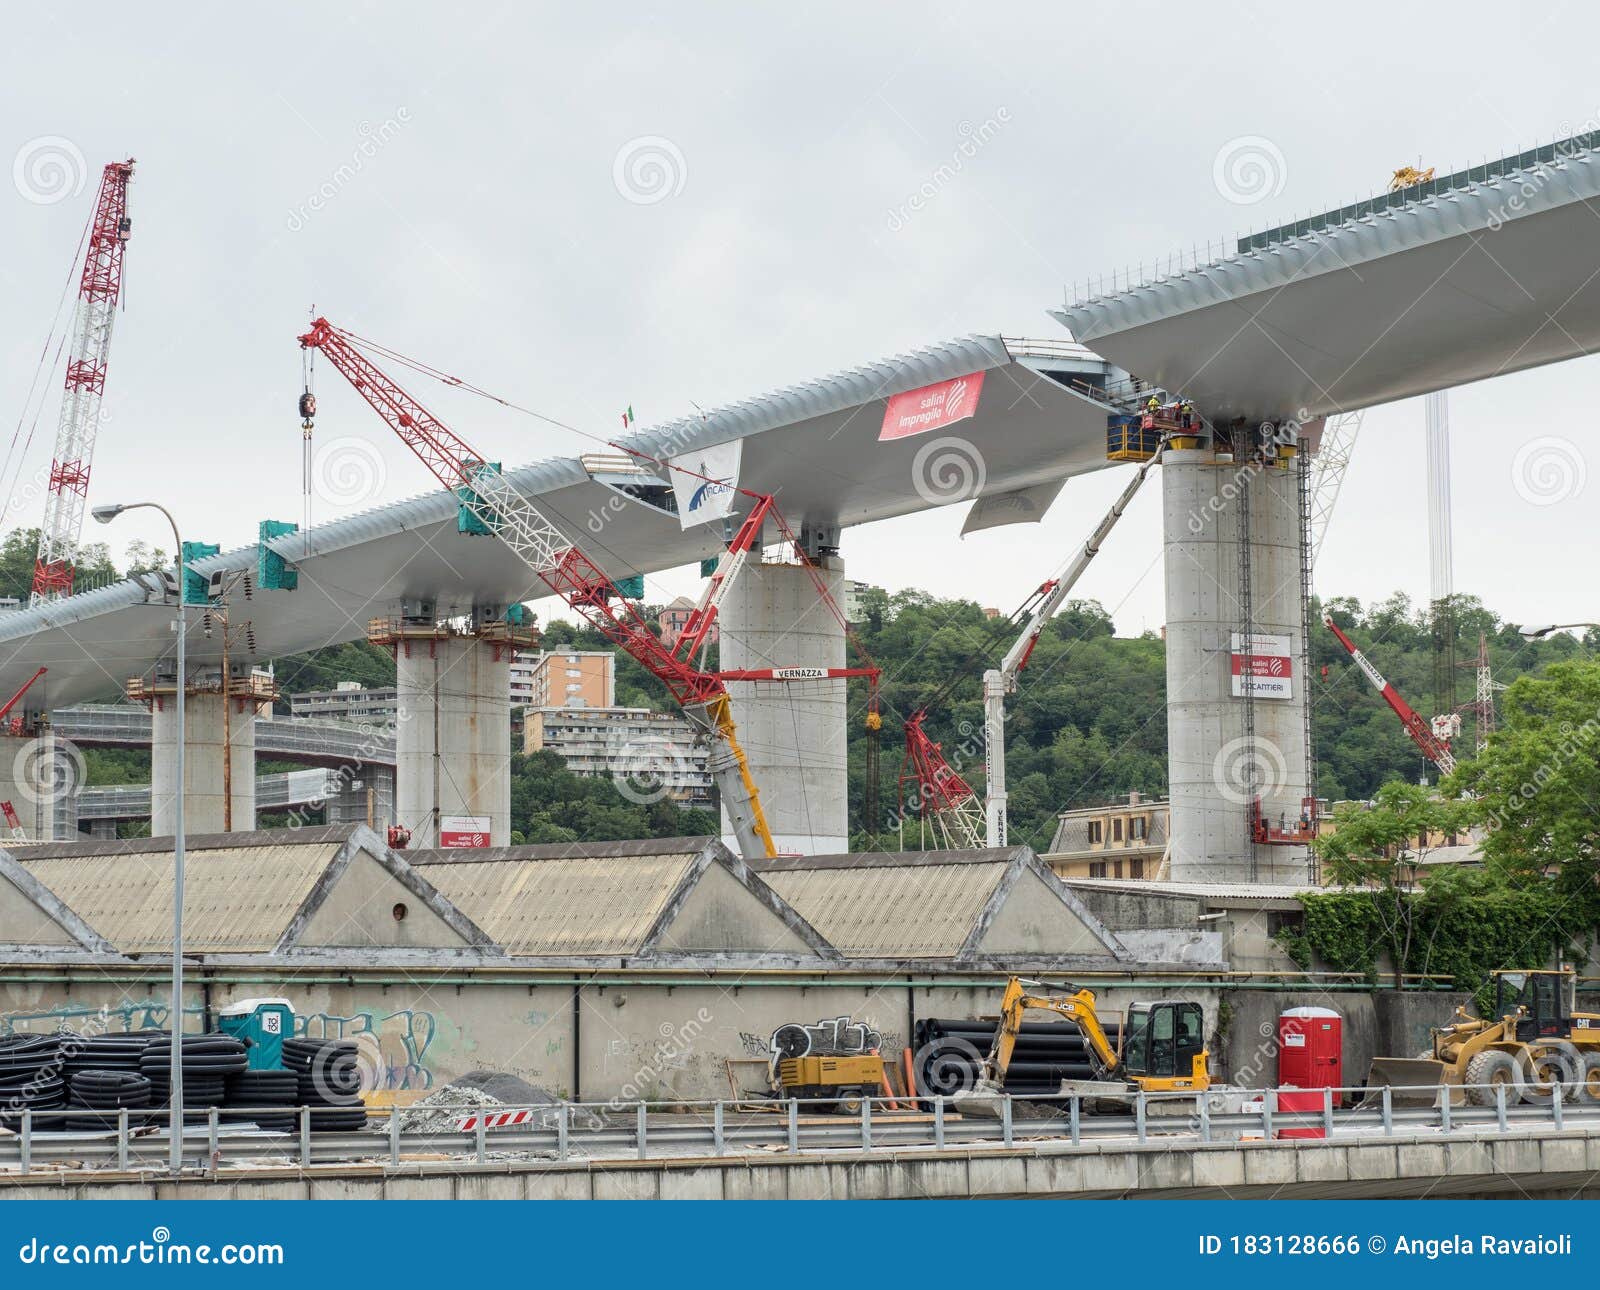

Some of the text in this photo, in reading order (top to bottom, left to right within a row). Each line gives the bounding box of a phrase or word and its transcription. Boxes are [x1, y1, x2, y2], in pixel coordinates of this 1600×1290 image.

[920, 391, 945, 409] salini
[1356, 651, 1384, 684] VERNAZZA
[778, 670, 823, 678] VERNAZZA
[1056, 1002, 1075, 1011] JCB
[1577, 1018, 1591, 1028] CAT
